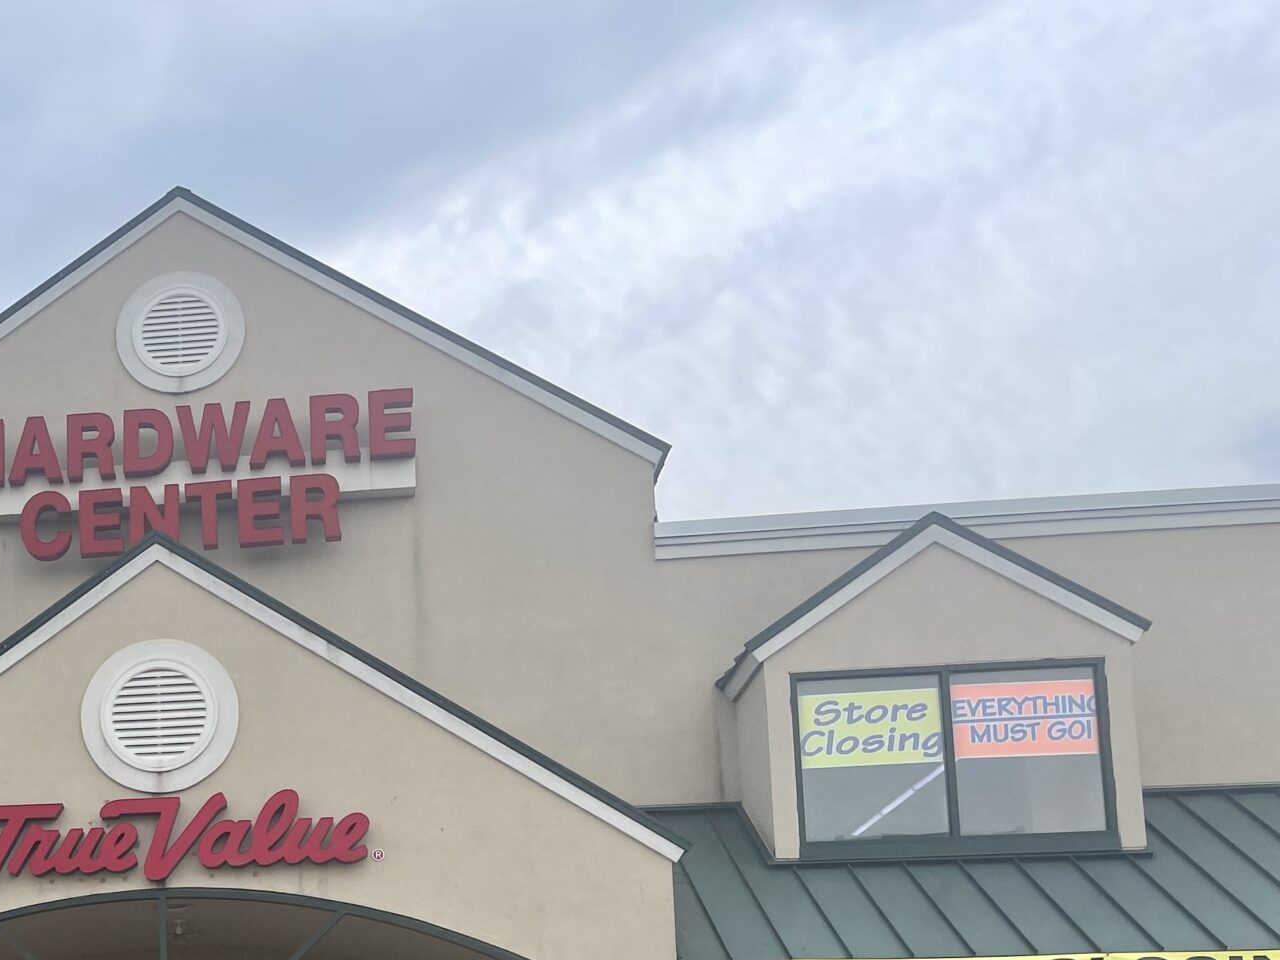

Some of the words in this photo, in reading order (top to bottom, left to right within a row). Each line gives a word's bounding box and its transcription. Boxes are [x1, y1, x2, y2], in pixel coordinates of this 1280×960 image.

[20, 473, 342, 561] CENTER
[813, 700, 928, 726] Store
[801, 727, 943, 757] Closing
[970, 722, 1040, 743] MUST
[100, 789, 370, 881] Value
